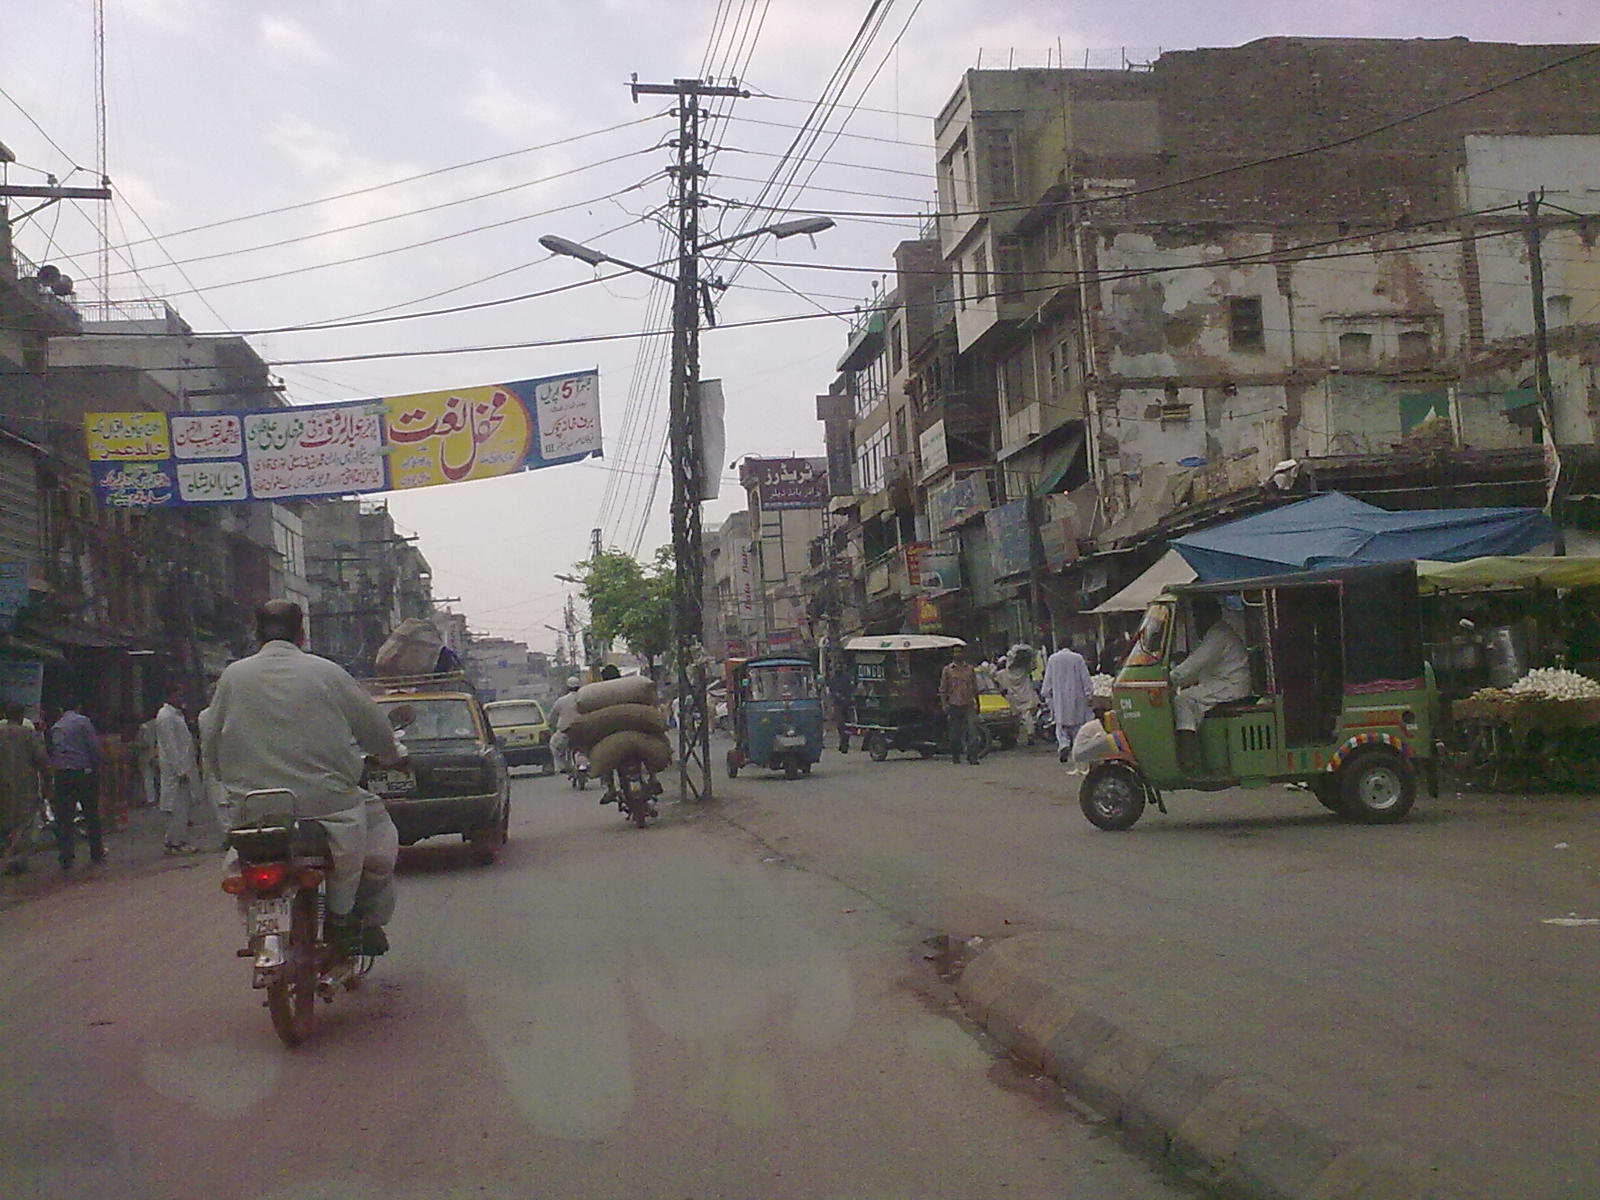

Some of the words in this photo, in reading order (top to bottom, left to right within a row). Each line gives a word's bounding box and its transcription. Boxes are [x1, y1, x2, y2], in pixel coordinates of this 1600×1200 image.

[541, 385, 560, 405] اپریل
[561, 380, 575, 399] 5
[764, 461, 814, 486] ٹریڈرز
